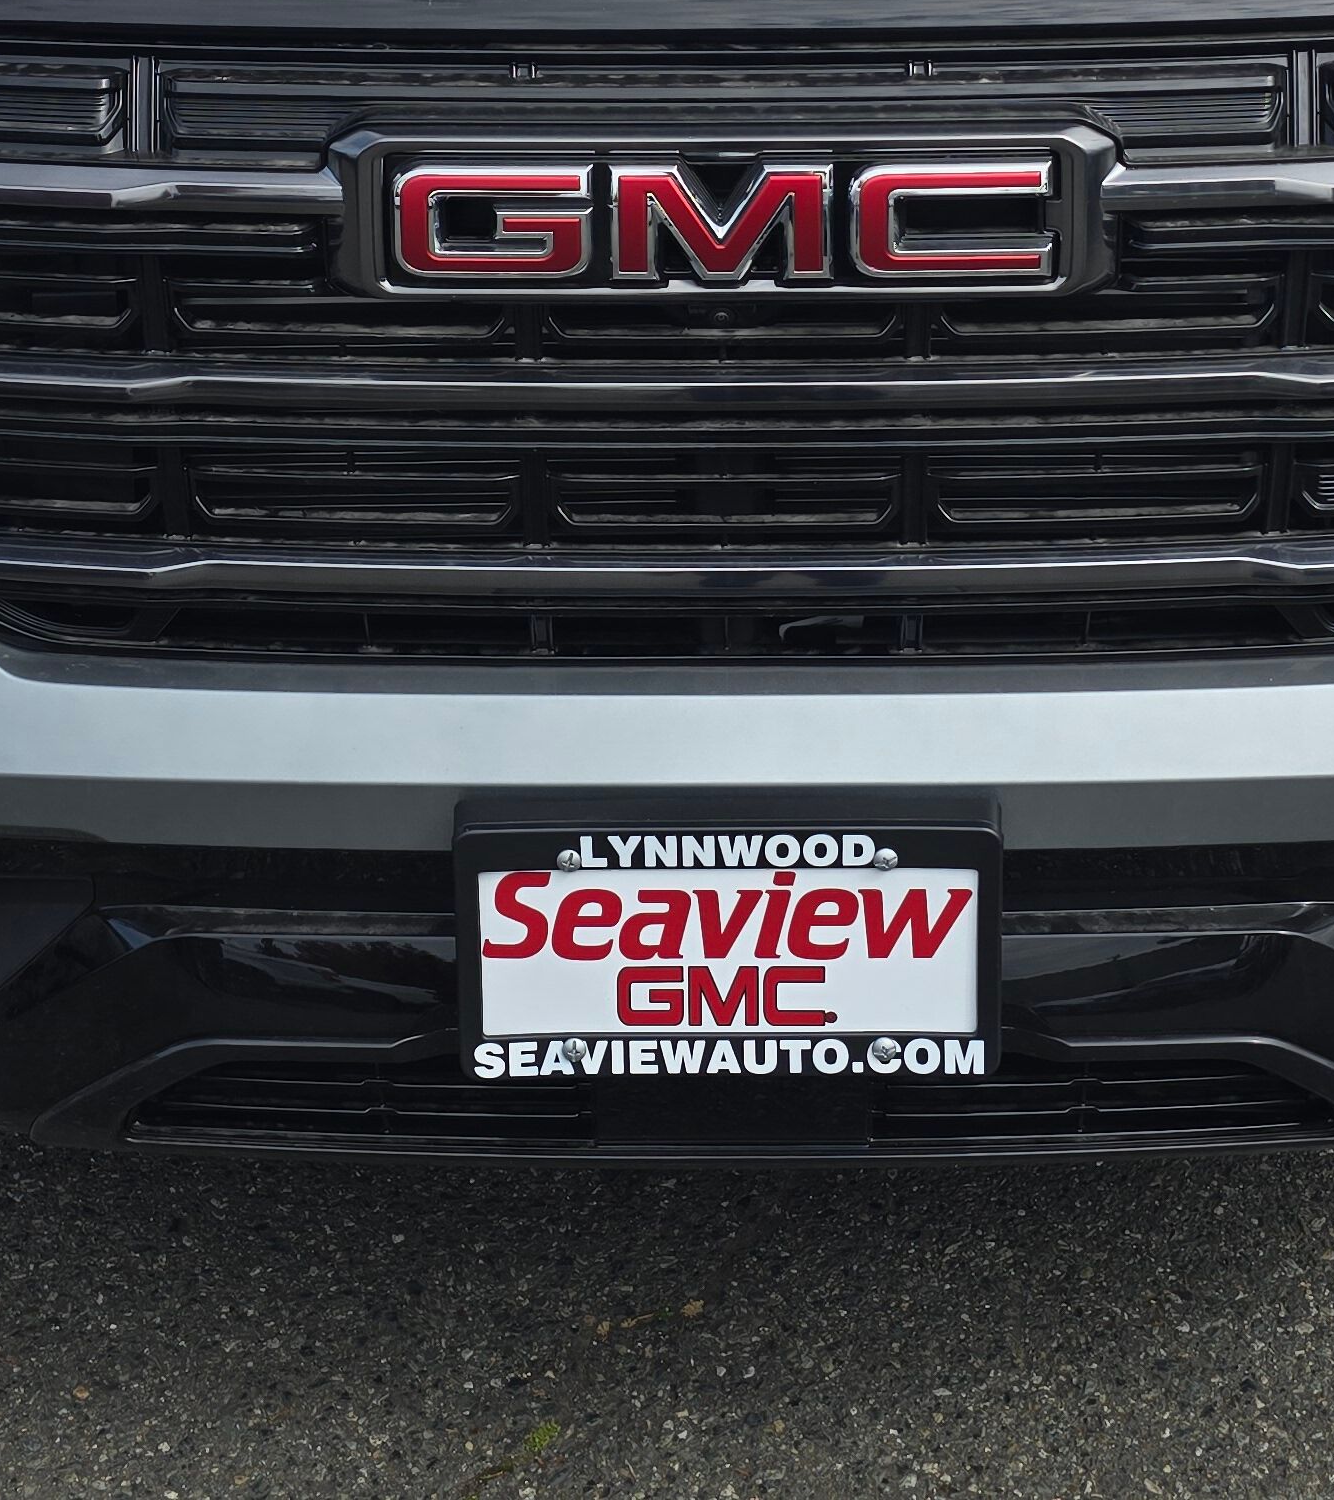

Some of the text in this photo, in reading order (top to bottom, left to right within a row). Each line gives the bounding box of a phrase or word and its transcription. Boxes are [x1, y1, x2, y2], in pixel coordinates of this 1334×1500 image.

[394, 164, 1054, 281] GMC
[579, 834, 876, 868] LYNNWOOD
[482, 871, 973, 961] Seaview
[616, 966, 827, 1026] GMC
[473, 1039, 986, 1078] SEAVIEWAUTO.COM
